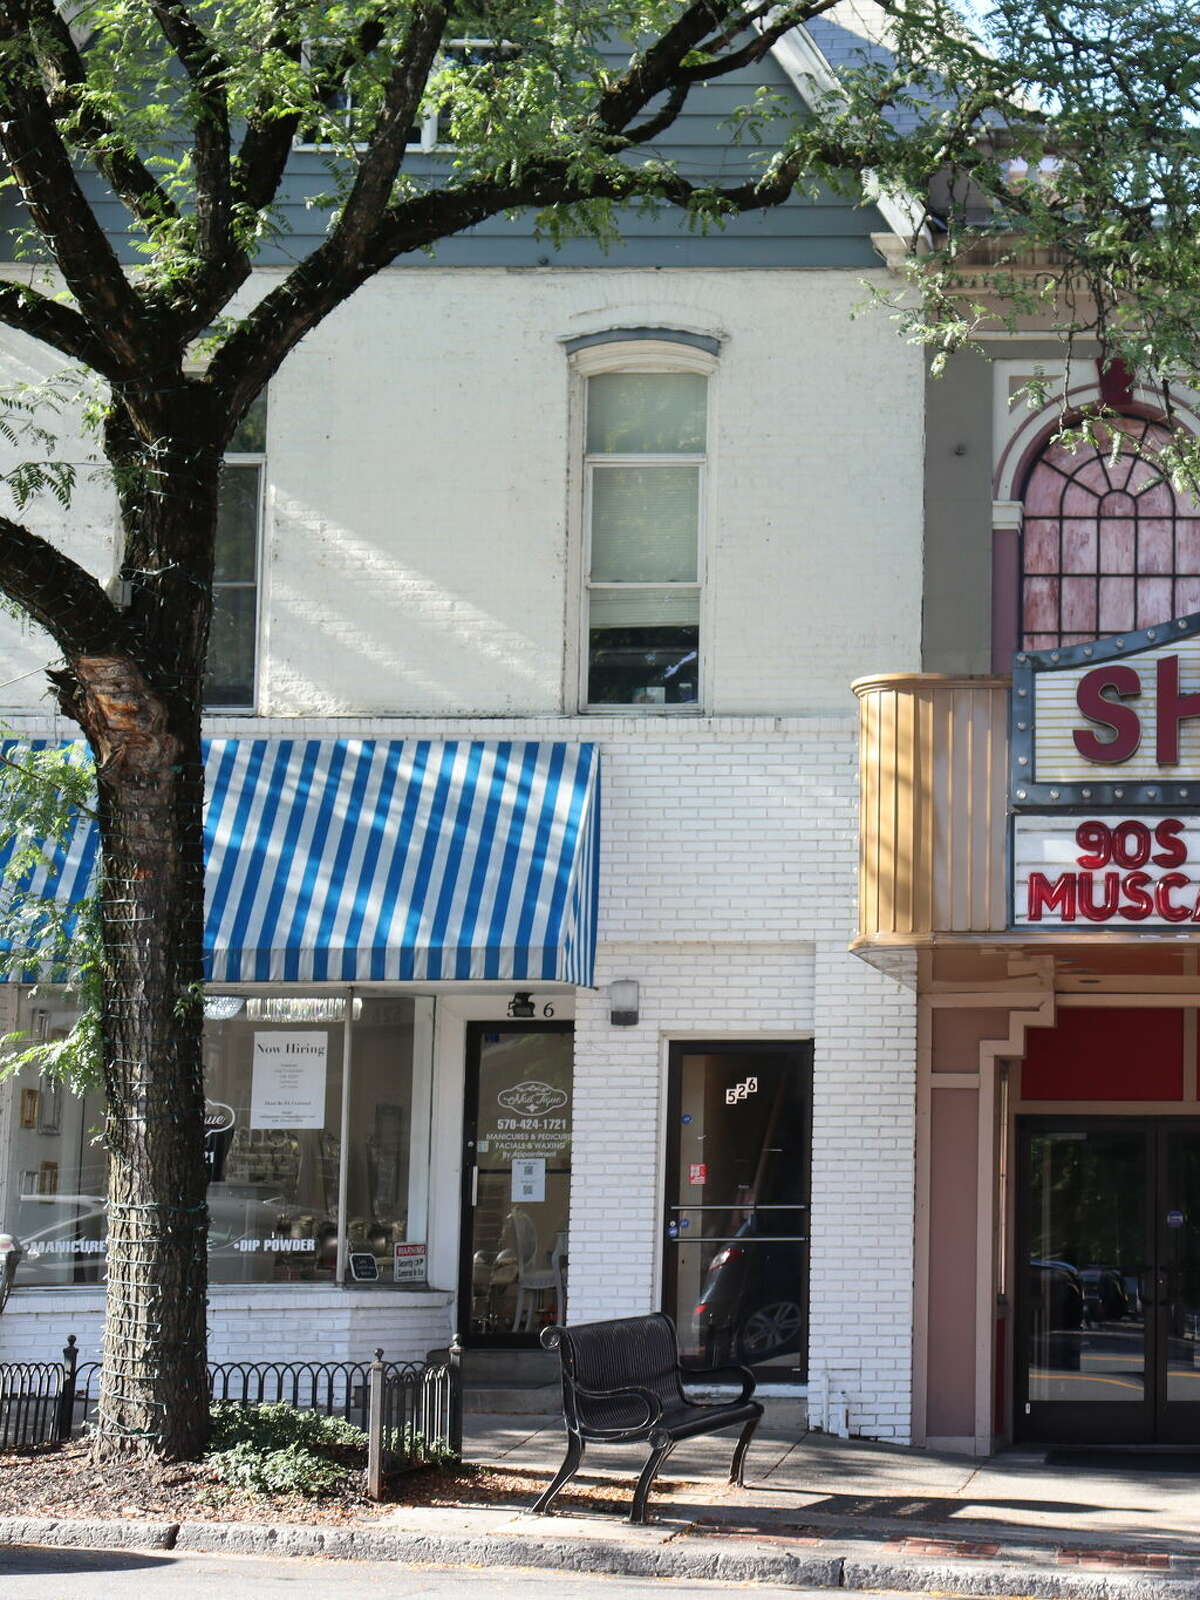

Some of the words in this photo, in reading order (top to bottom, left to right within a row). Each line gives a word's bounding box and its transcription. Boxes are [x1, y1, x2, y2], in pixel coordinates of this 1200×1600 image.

[1075, 818, 1187, 870] 90S
[257, 1043, 280, 1054] Now
[286, 1043, 327, 1056] Hiring
[727, 1077, 758, 1104] 526
[497, 1119, 567, 1130] 570-424-1721
[239, 1239, 260, 1251] DIP
[264, 1239, 315, 1251] POWDER
